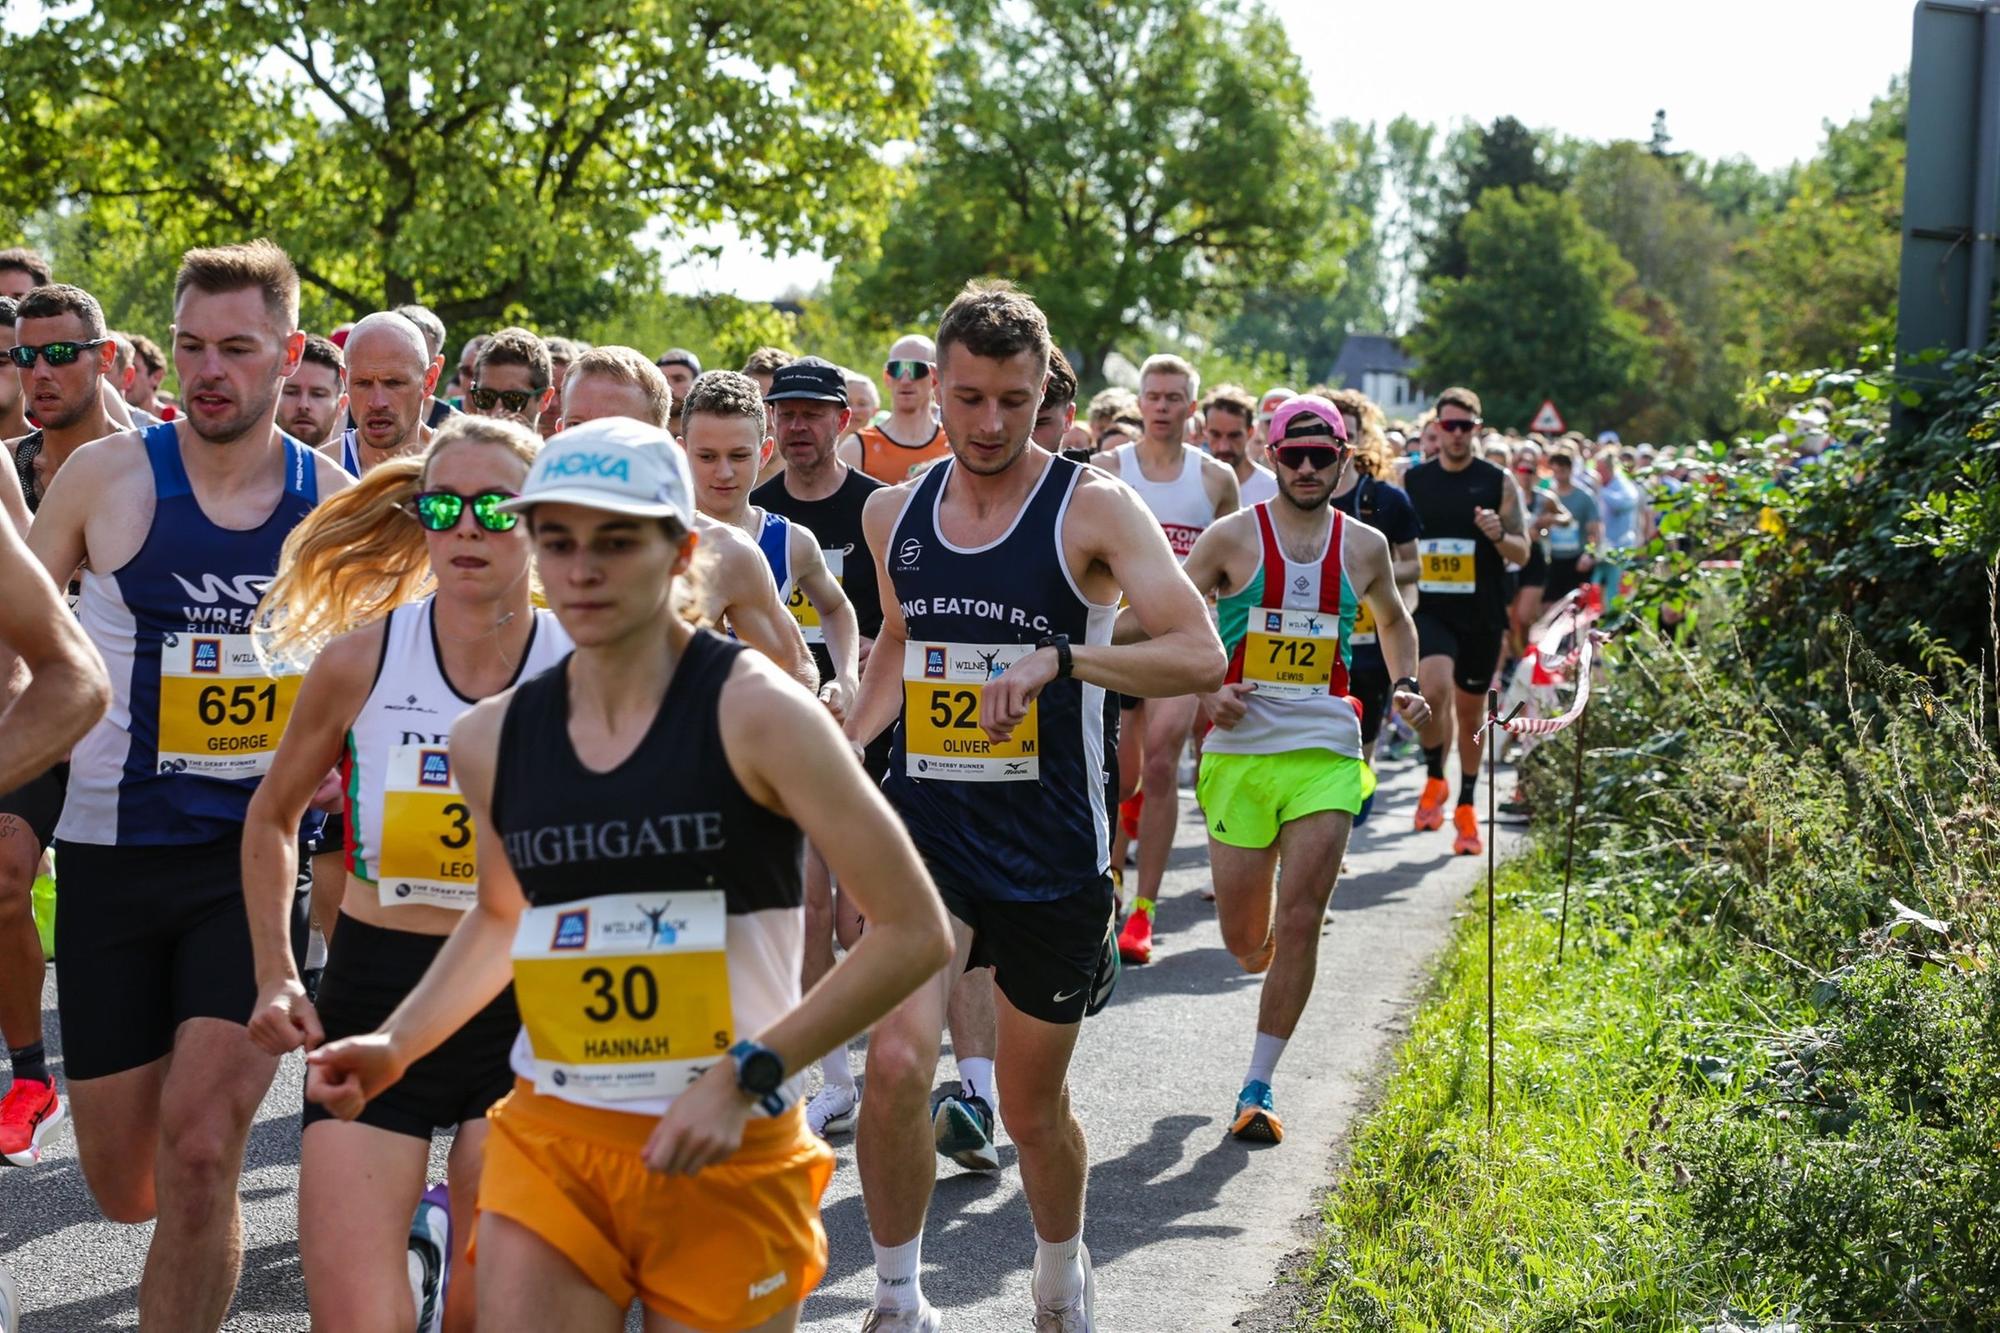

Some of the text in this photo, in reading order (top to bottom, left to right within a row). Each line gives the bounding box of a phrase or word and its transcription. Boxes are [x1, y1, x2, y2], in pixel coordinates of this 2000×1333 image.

[541, 453, 631, 485] HOKA
[1166, 527, 1201, 543] TON
[1431, 556, 1460, 573] 819
[901, 597, 1053, 635] NG EATON R.C.
[195, 658, 216, 667] ALDI
[1268, 639, 1316, 667] 712
[927, 664, 944, 673] ALDI
[1276, 670, 1329, 682] LEWIS M
[198, 683, 277, 726] 651
[930, 690, 978, 729] 52
[207, 734, 268, 751] GEORGE
[943, 739, 1035, 754] OLIVER M
[422, 771, 448, 782] ALDI
[440, 803, 471, 849] 3
[504, 812, 727, 870] HIGHGATE
[440, 862, 475, 878] LEO
[581, 964, 659, 1022] 30
[584, 1031, 730, 1058] HANNAH S
